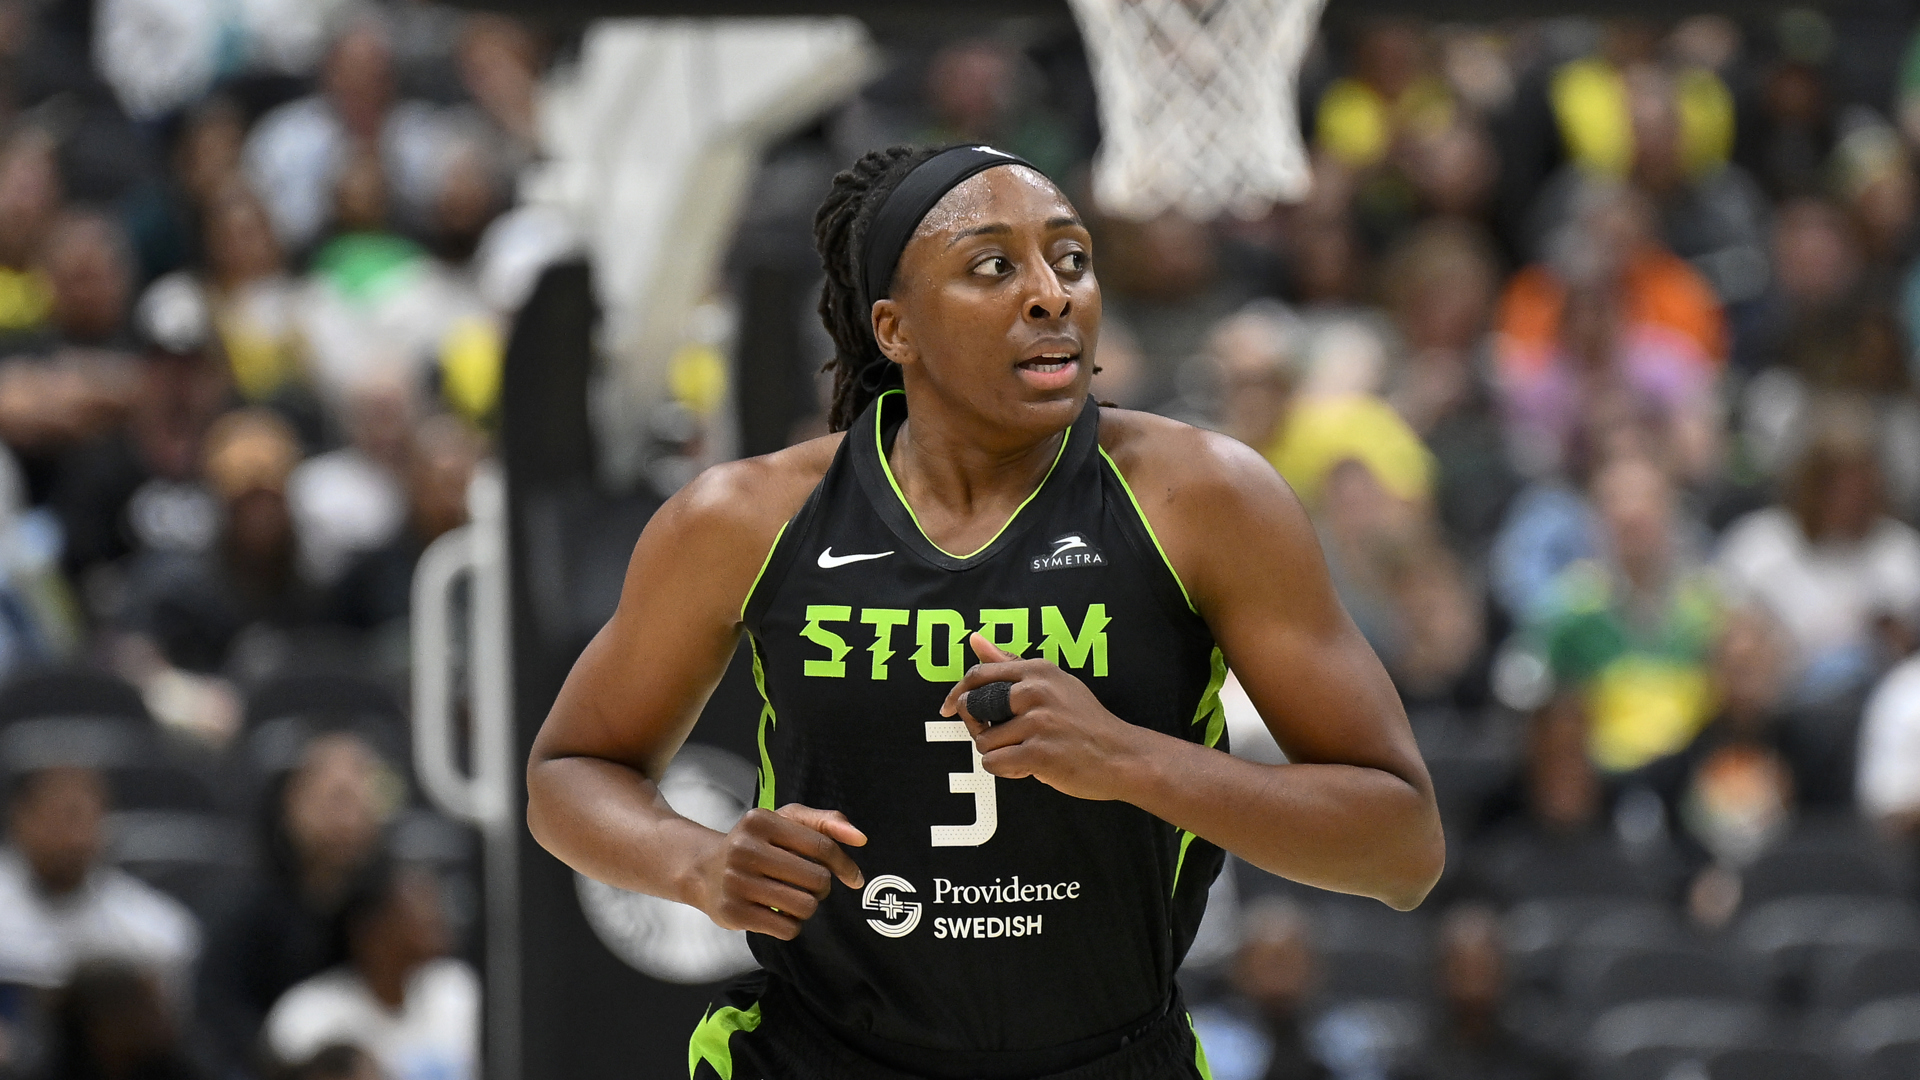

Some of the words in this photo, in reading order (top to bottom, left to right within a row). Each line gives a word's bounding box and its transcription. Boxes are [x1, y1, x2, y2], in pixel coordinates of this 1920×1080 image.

[1033, 553, 1102, 570] SYMETRA
[925, 721, 997, 847] 3
[933, 875, 1081, 904] Providence
[934, 914, 1043, 939] SWEDISH
